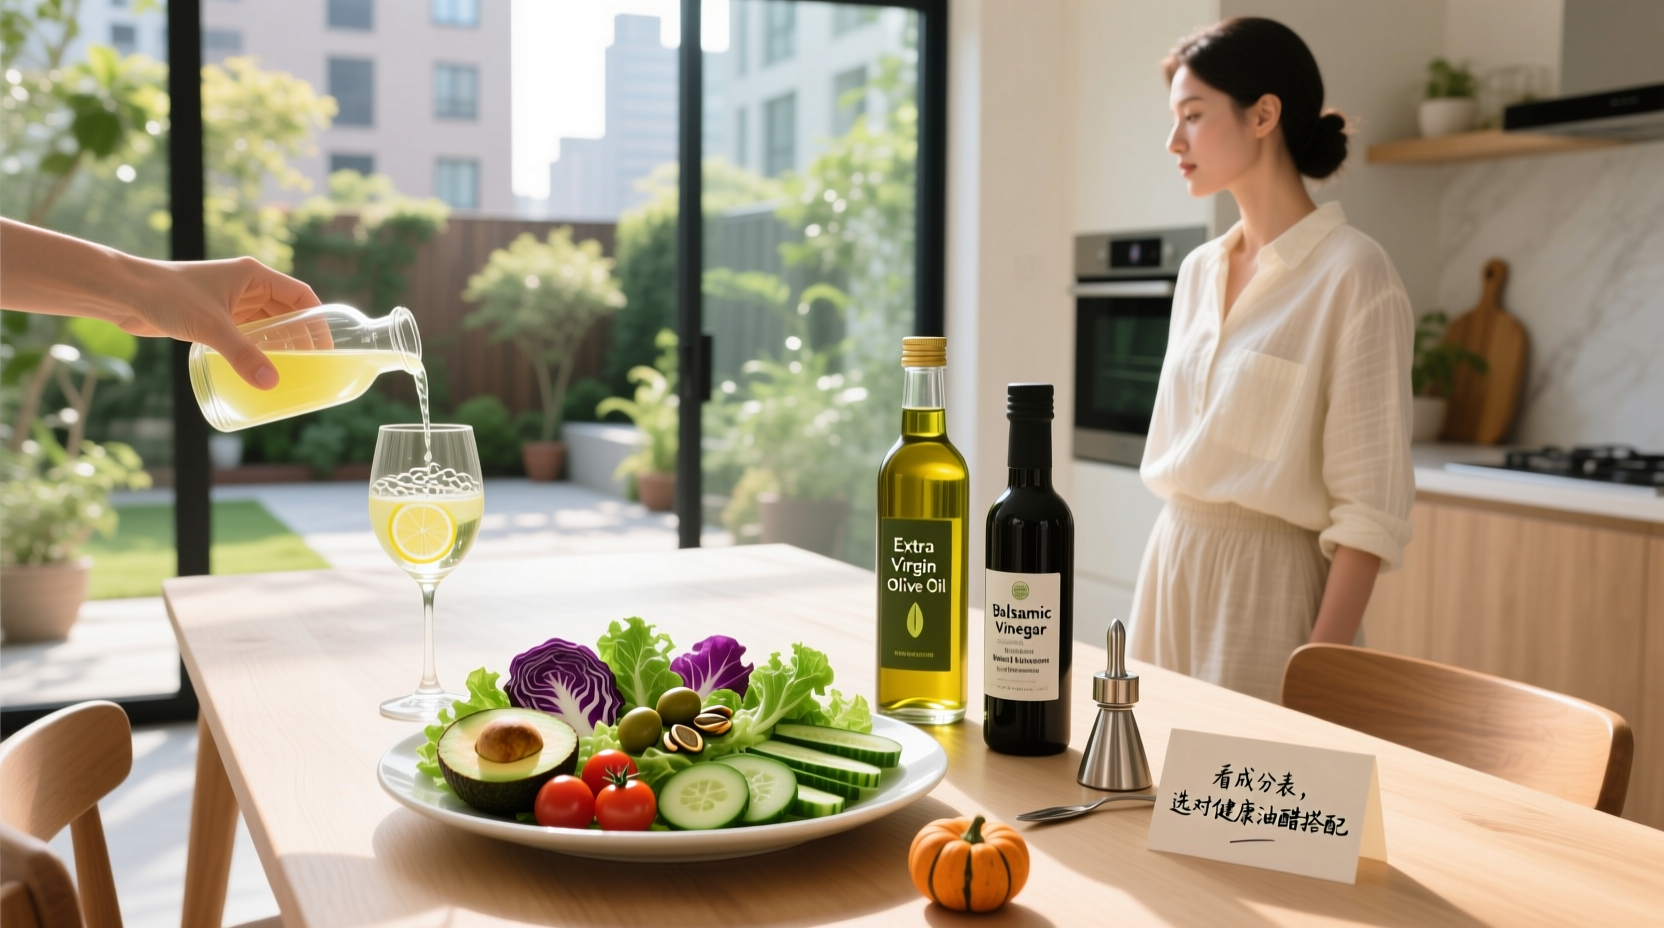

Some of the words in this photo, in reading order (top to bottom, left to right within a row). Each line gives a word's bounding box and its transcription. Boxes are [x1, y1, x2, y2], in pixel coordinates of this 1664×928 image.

[893, 537, 935, 554] Extra
[891, 556, 937, 577] Virgin
[887, 577, 924, 593] Olive
[926, 578, 946, 593] Oil
[992, 603, 1052, 619] Balsamic
[995, 620, 1047, 639] Vinegar
[1212, 763, 1306, 801] 看成分表，
[1169, 789, 1349, 837] 选对健康油醋搭配
